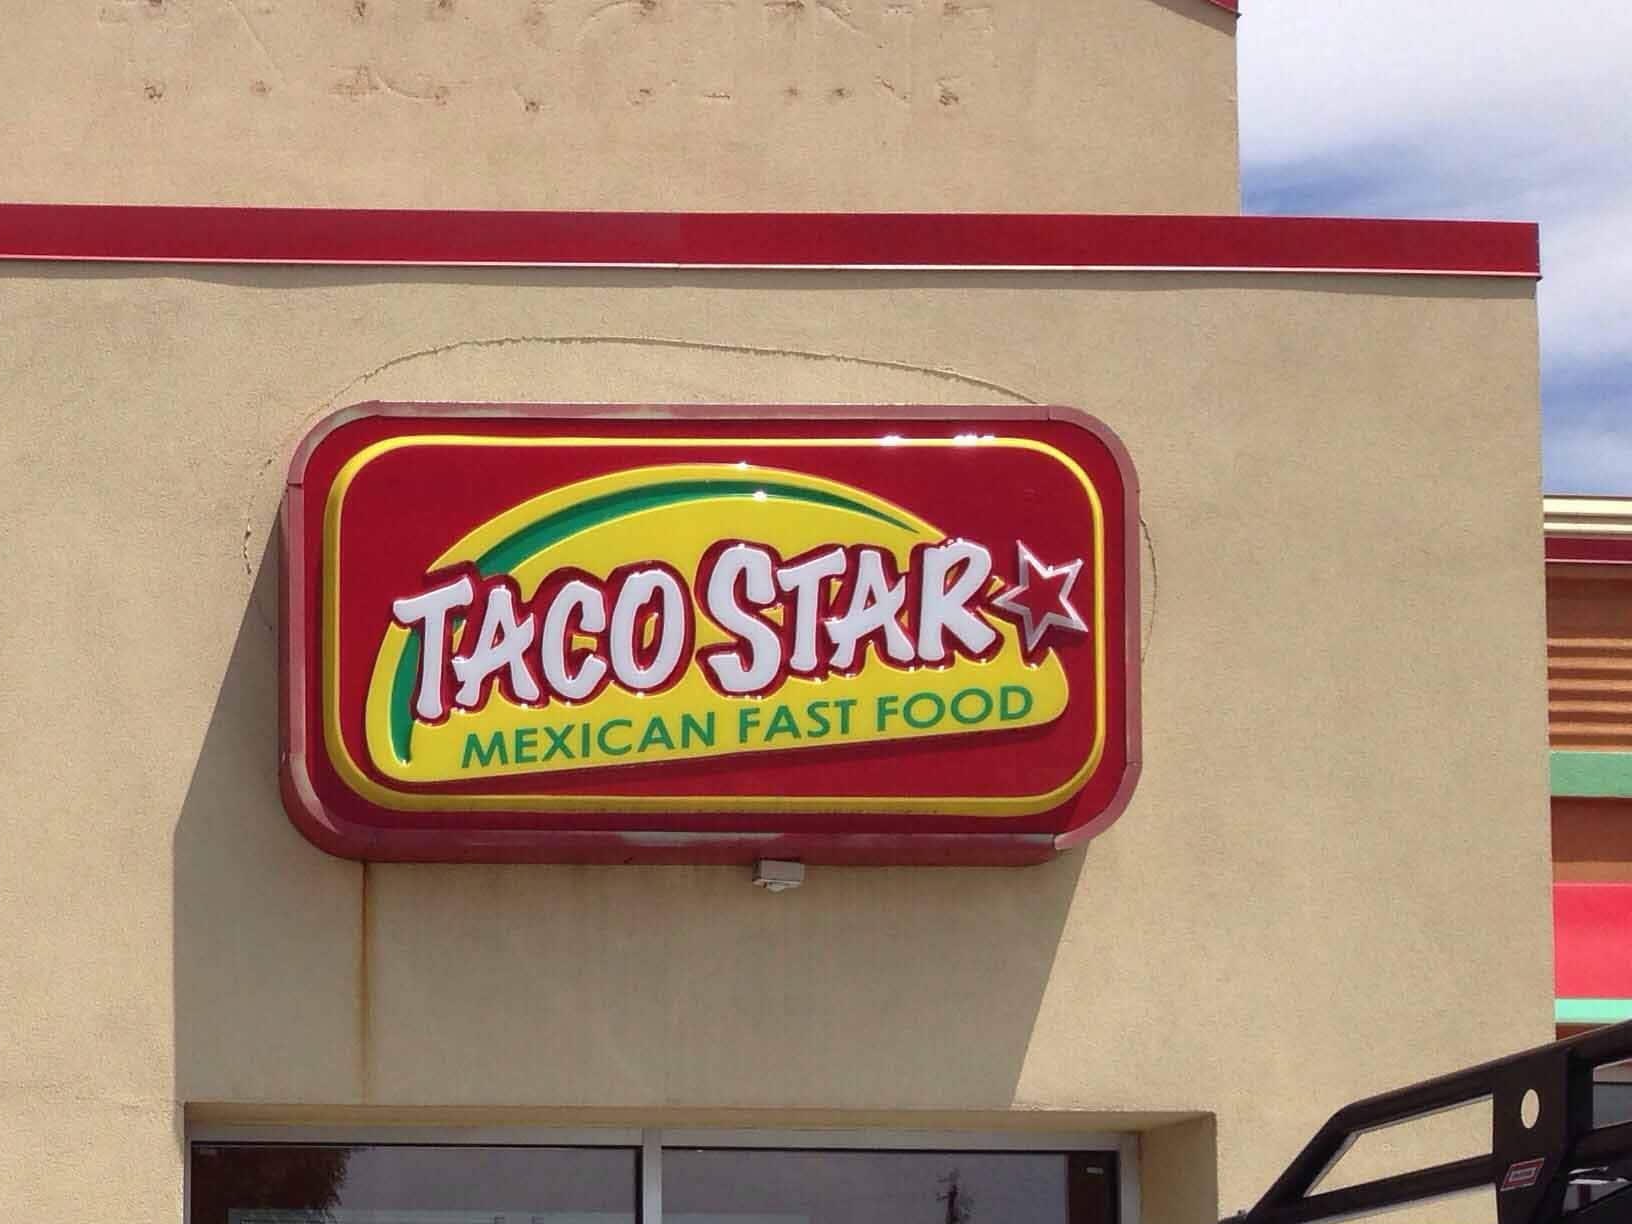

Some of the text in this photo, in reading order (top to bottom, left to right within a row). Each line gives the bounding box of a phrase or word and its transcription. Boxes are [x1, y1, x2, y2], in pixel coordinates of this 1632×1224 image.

[392, 538, 1002, 721] TACO STAR
[461, 685, 1034, 769] MEXICAN FAST FOOD
